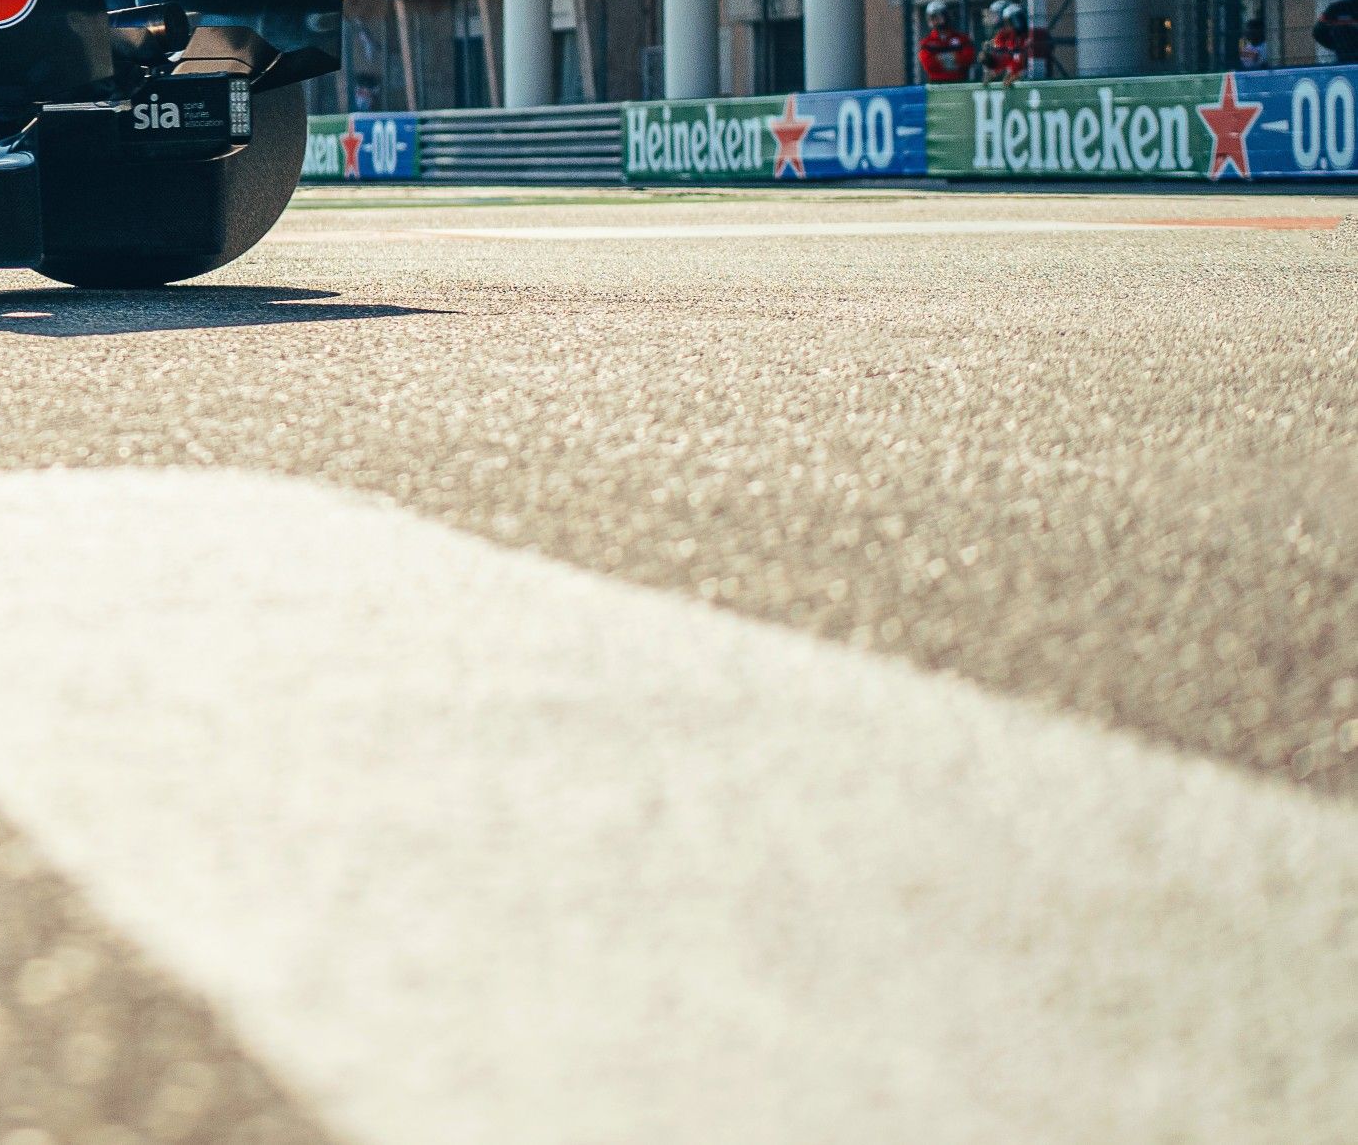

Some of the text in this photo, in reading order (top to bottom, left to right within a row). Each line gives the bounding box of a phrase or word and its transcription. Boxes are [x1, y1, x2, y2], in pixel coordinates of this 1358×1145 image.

[133, 93, 181, 130] sia
[627, 97, 894, 172] Heineken 0.0
[973, 77, 1356, 172] Heineken 0.0
